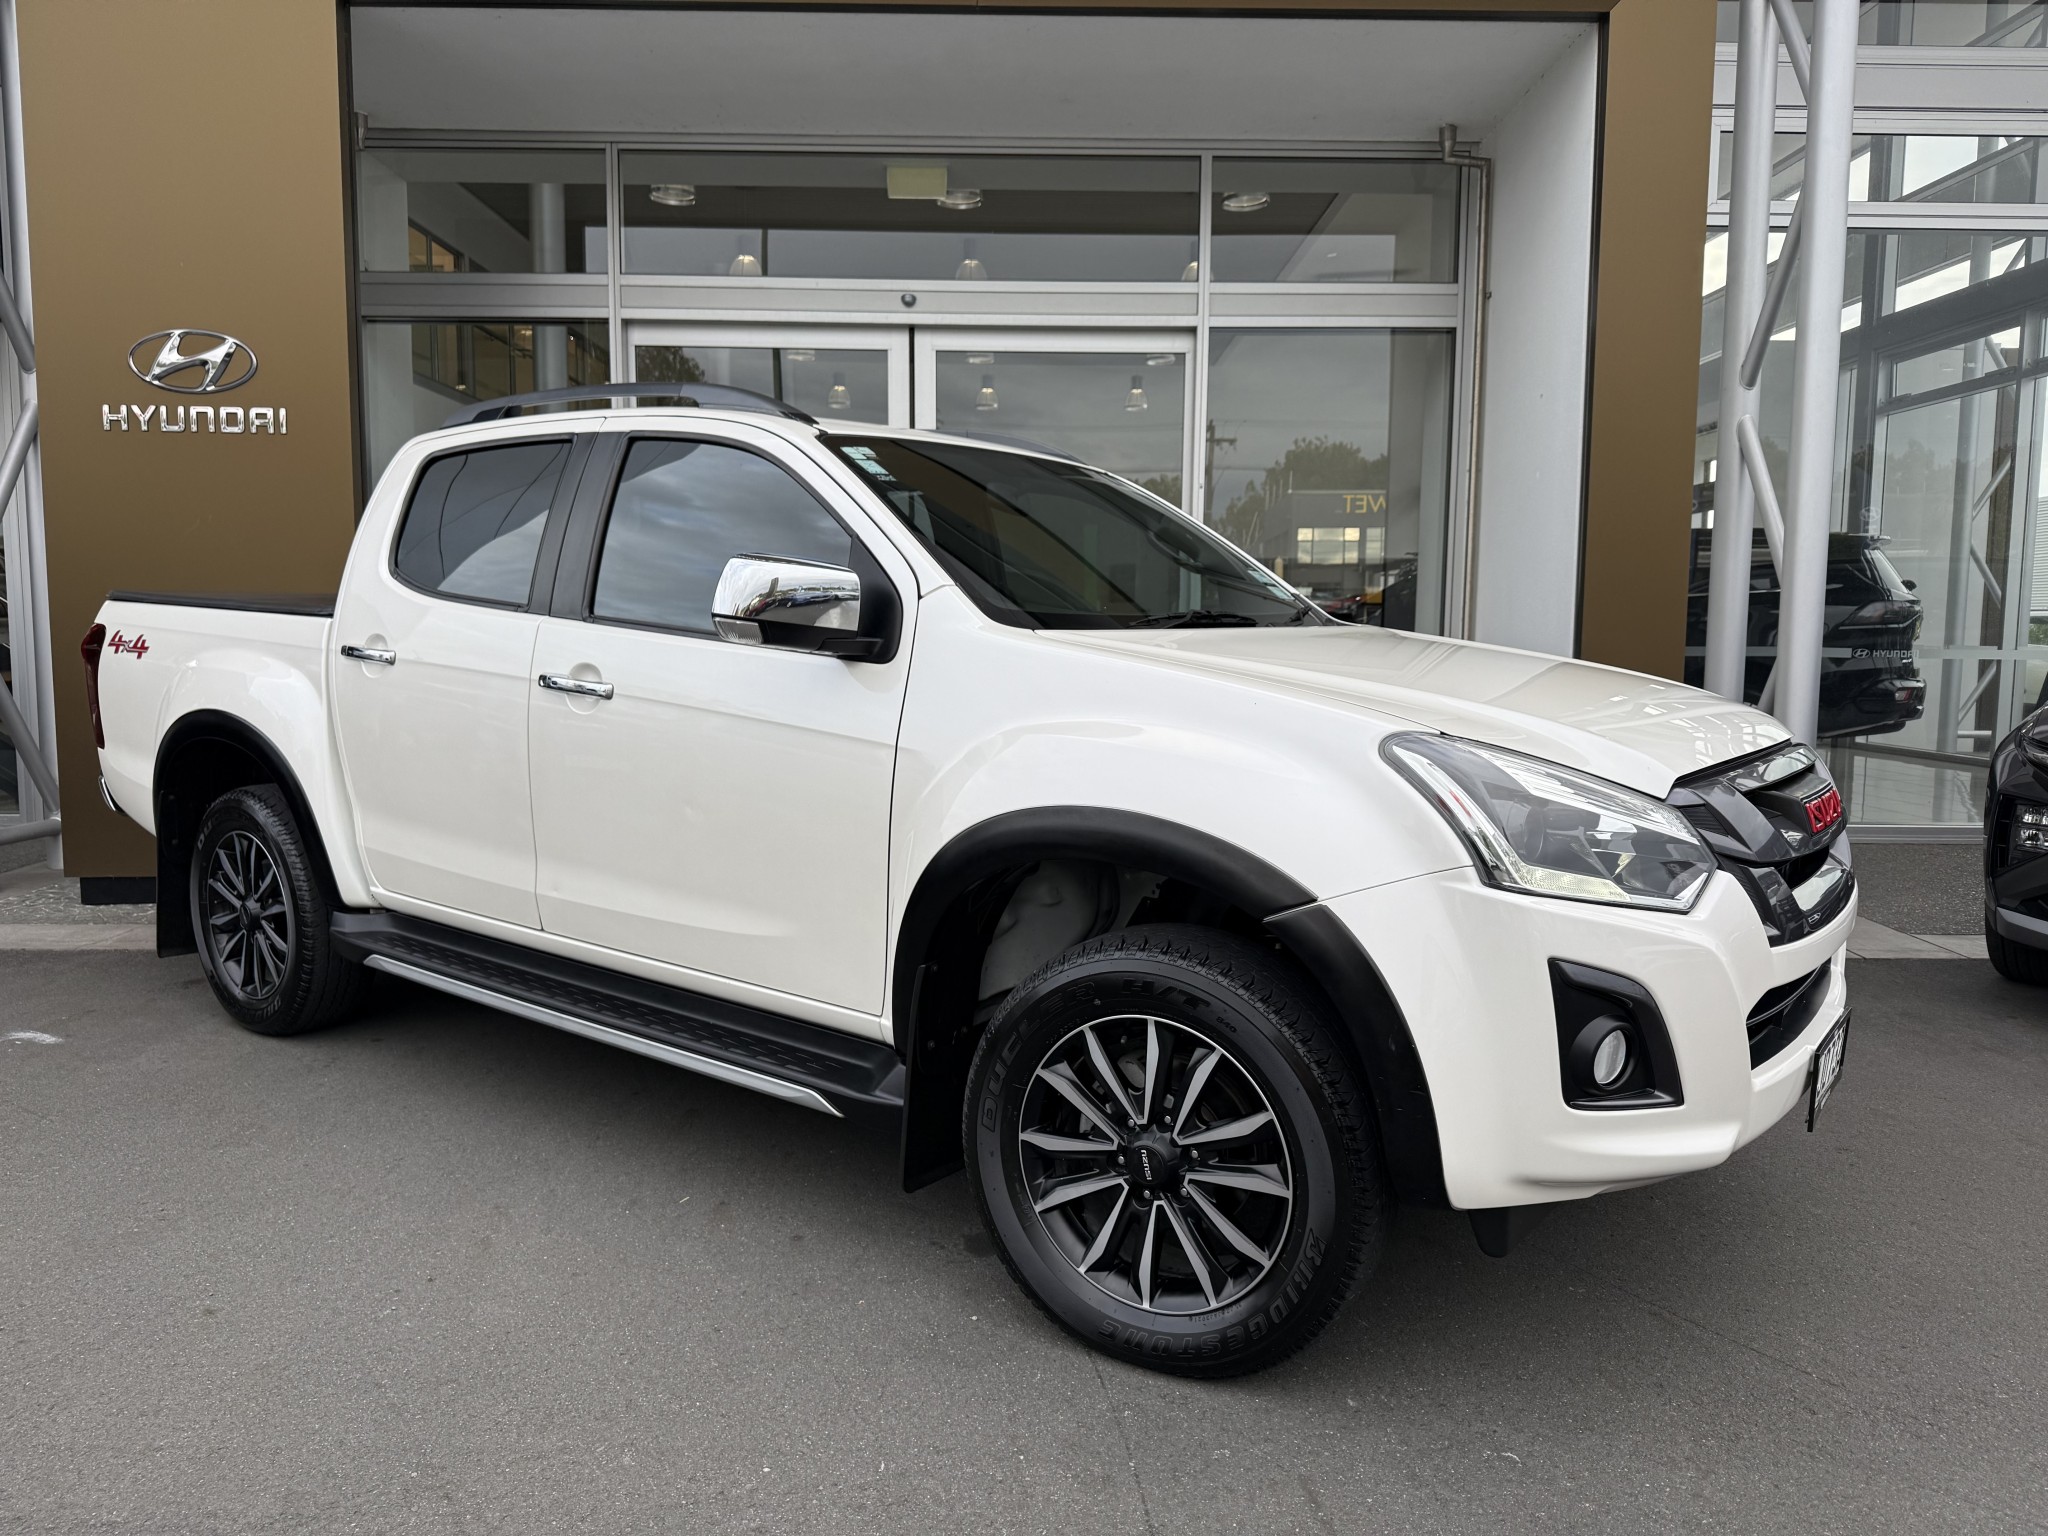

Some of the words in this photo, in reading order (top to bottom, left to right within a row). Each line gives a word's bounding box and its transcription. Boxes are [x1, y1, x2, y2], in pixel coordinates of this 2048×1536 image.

[102, 404, 288, 435] HYUNDAI
[107, 629, 150, 660] 4x4
[1872, 649, 1920, 658] HYUNDAI
[1121, 977, 1212, 1011] H/T
[1140, 1149, 1153, 1181] ISUZU
[1098, 1228, 1328, 1358] BRIDGESTONE
